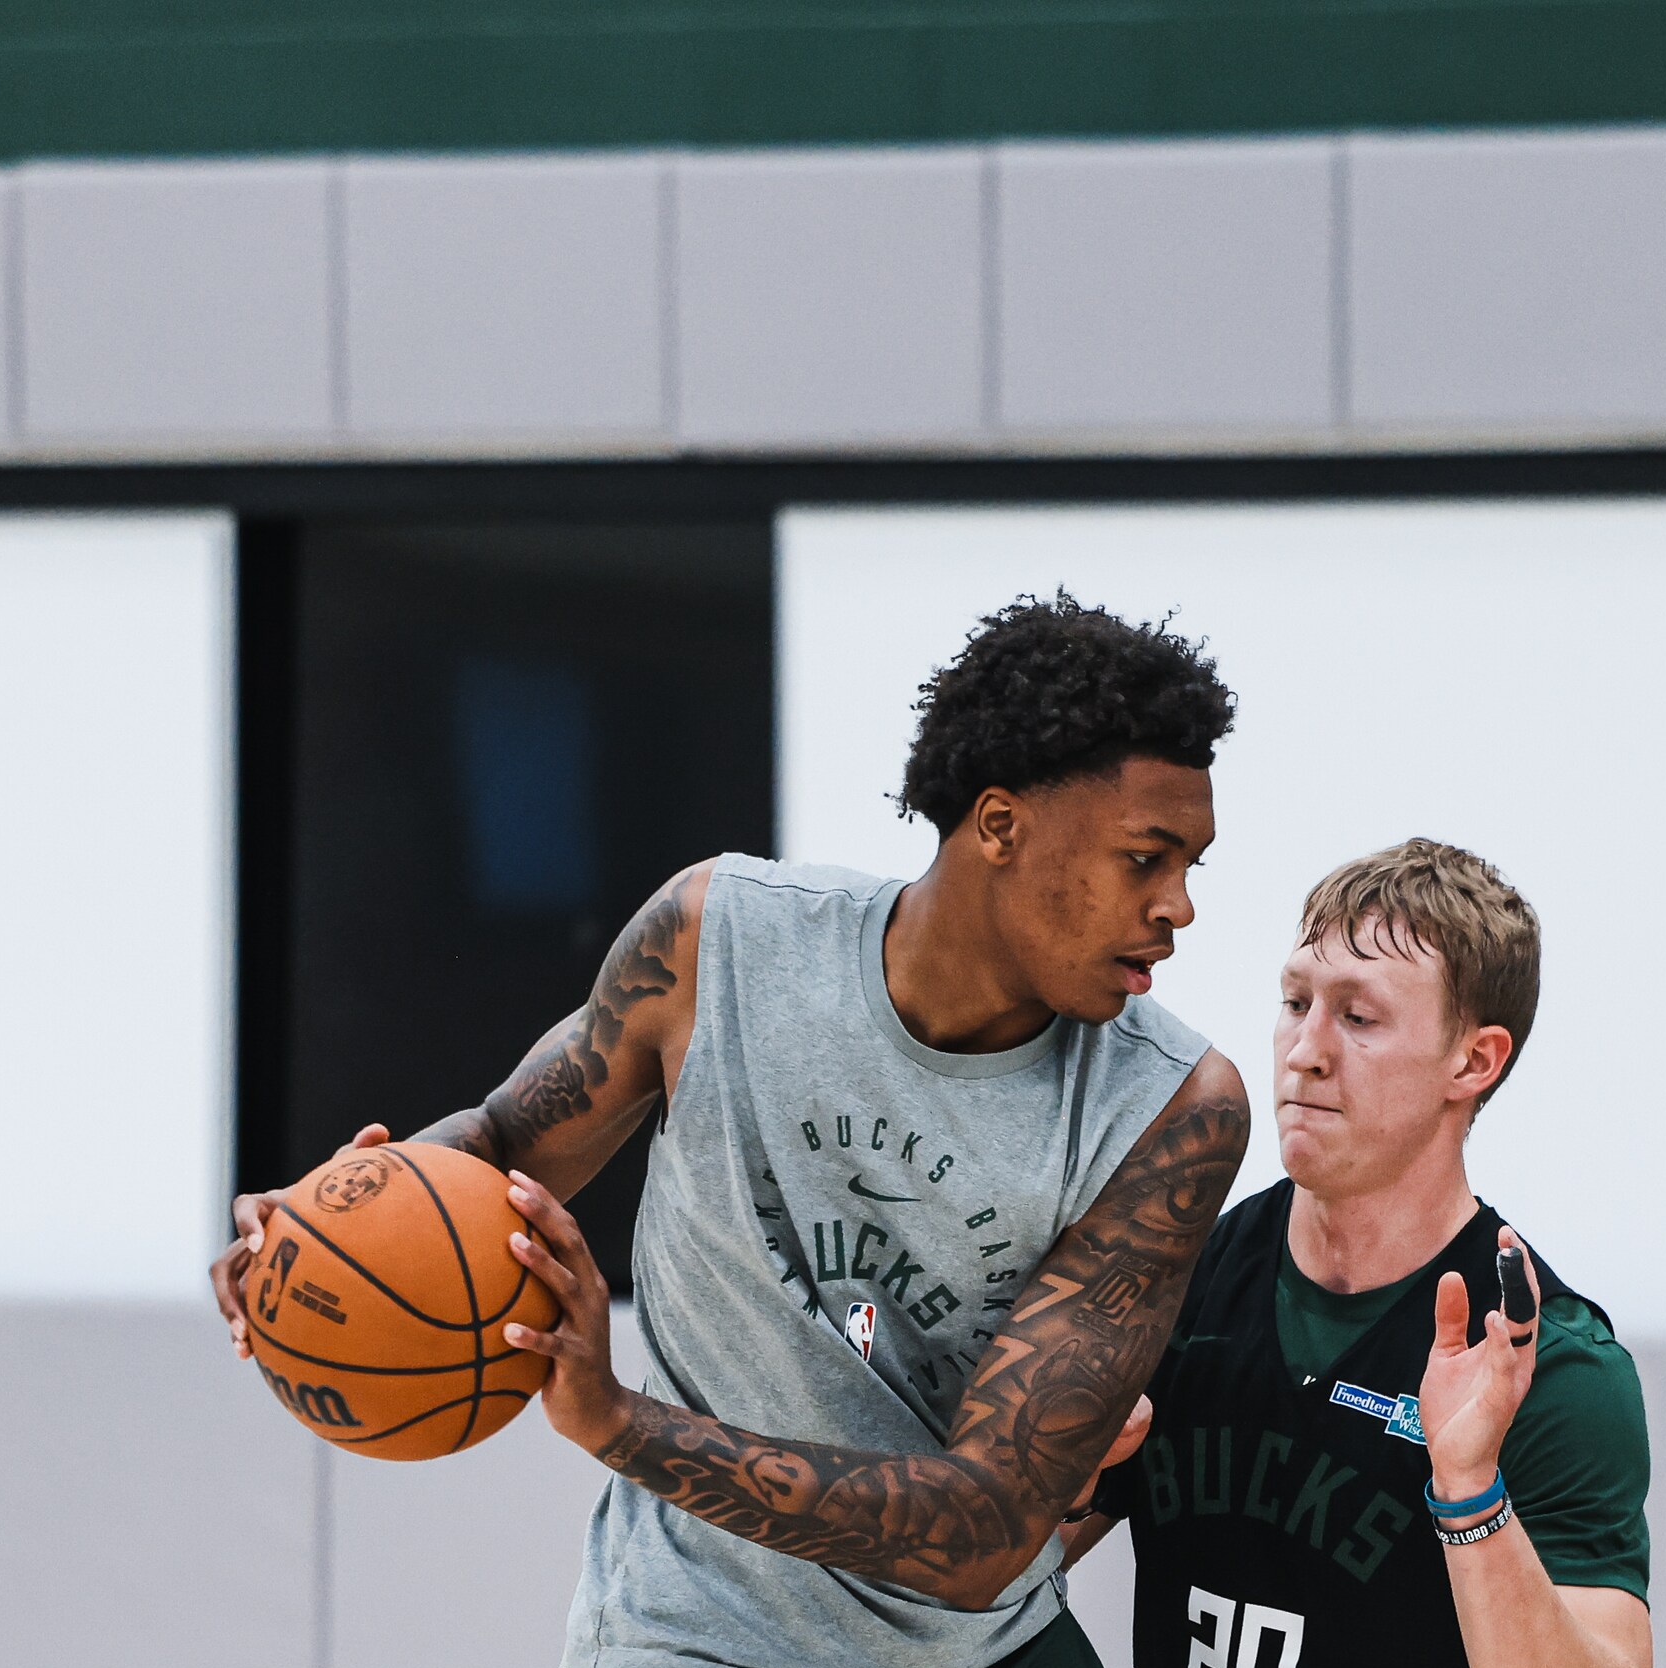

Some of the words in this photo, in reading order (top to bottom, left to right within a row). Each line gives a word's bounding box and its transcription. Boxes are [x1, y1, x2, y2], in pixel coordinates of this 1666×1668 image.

[800, 1115, 954, 1184] BUCKS
[814, 1218, 962, 1331] UCKS
[1335, 1386, 1394, 1417] Froedtert
[1140, 1425, 1415, 1584] BUCKS
[1459, 1524, 1489, 1544] LORD
